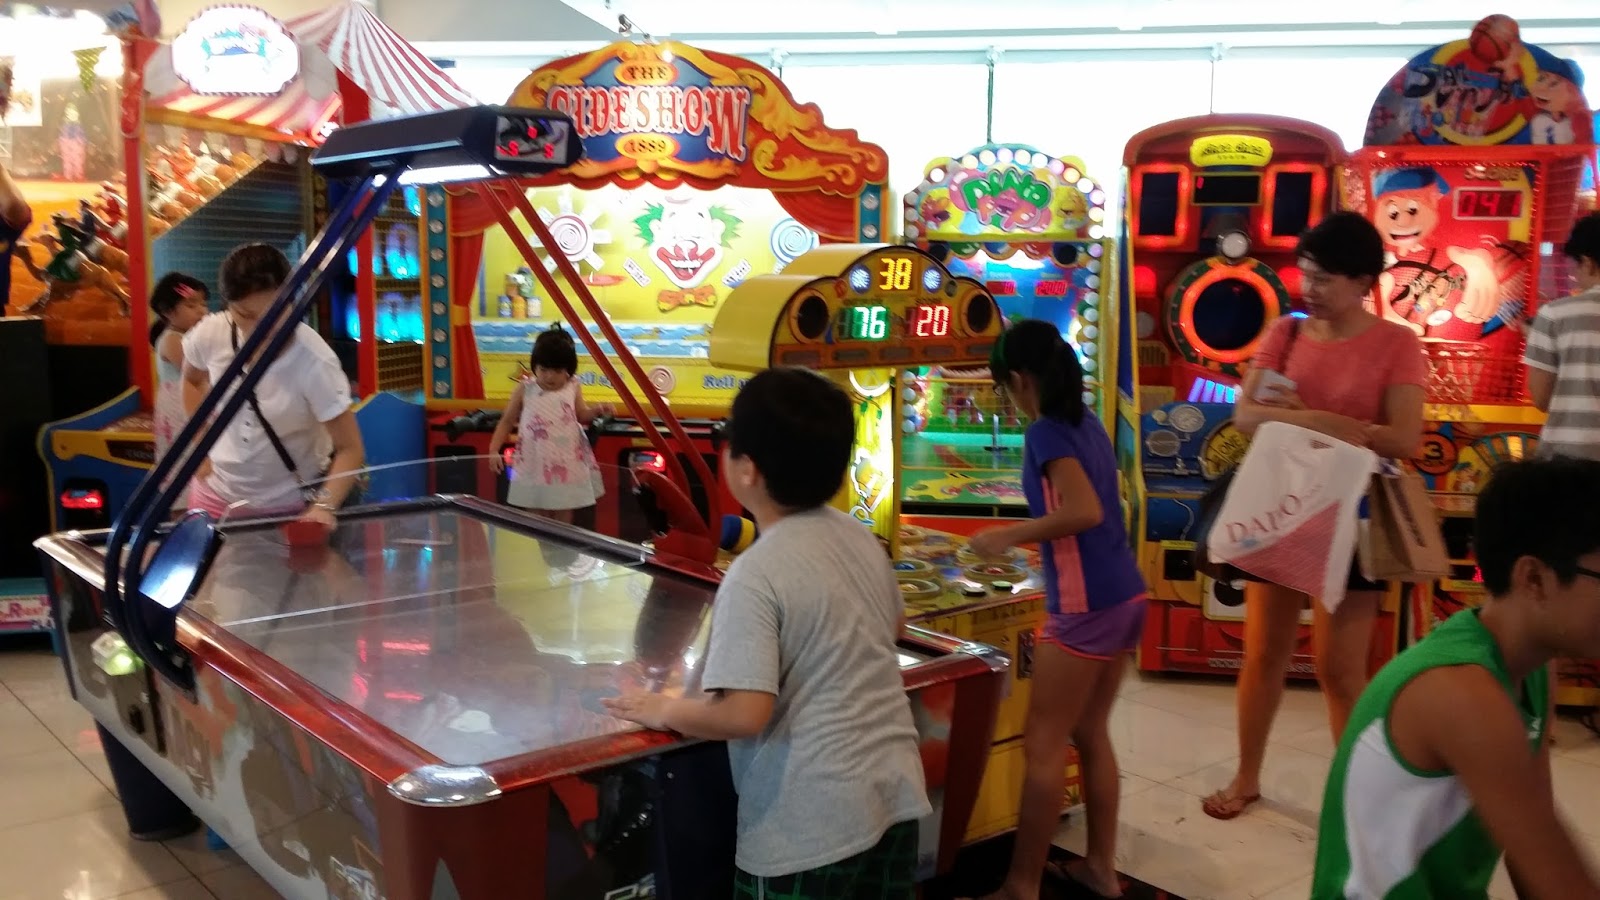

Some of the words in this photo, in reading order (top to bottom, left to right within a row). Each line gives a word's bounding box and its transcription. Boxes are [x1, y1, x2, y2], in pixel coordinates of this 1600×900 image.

[626, 65, 669, 79] THE
[548, 84, 751, 162] SIDESHOW
[879, 257, 913, 291] 38
[854, 305, 887, 339] 76
[916, 305, 949, 337] 20
